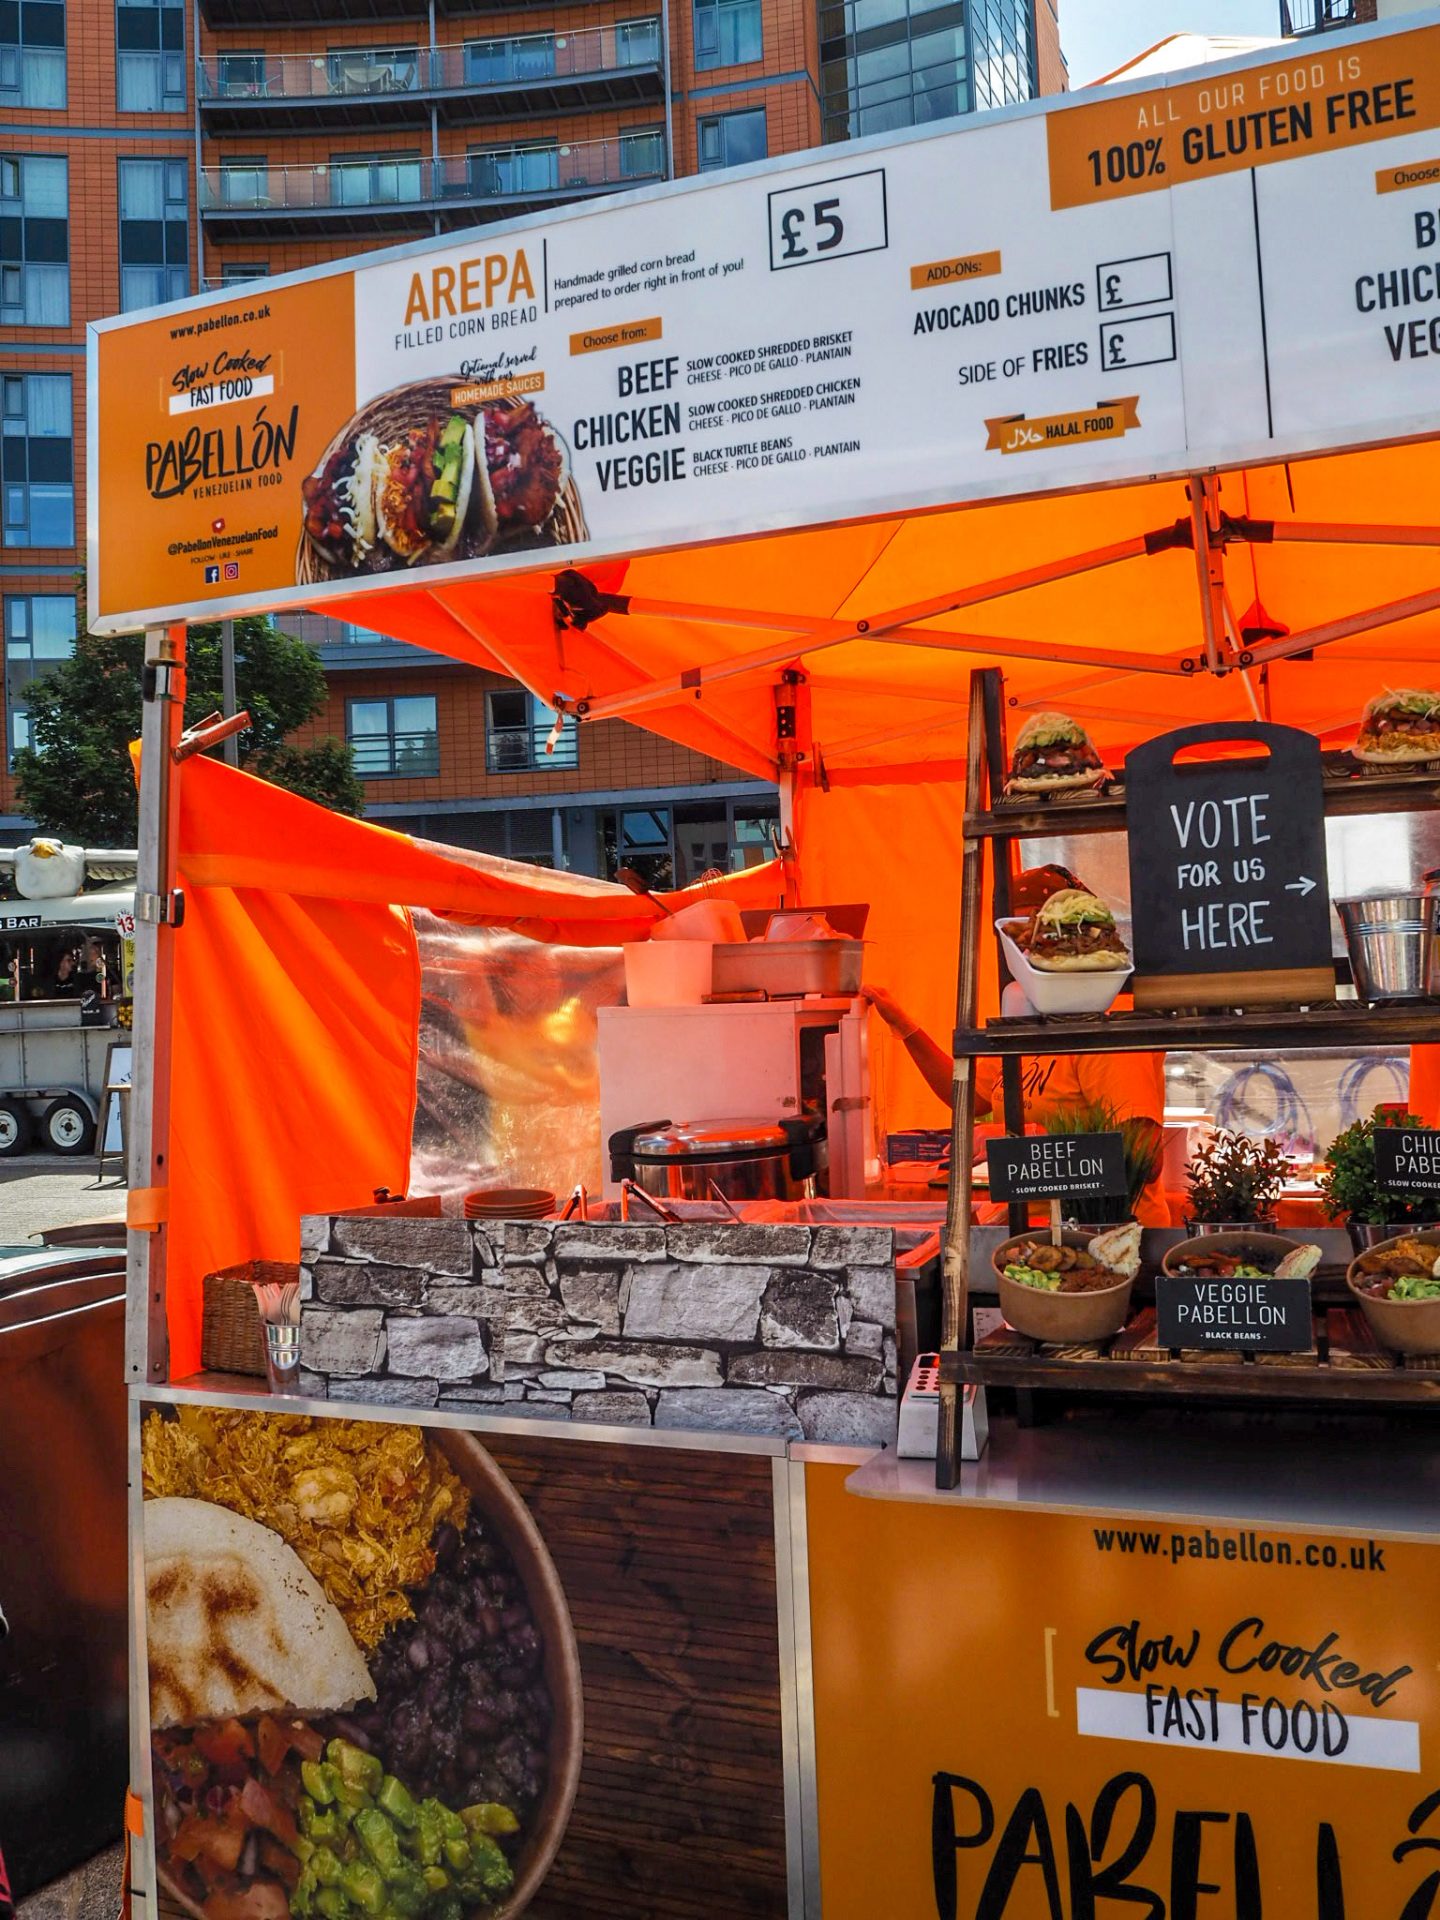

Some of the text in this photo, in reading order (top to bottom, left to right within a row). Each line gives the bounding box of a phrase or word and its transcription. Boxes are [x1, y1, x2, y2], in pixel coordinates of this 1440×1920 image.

[1138, 56, 1362, 130] ALL OUR FOOD IS
[1087, 78, 1416, 187] 100% GLUTEN FREE
[780, 198, 845, 260] £5
[404, 248, 535, 326] AREPA
[554, 249, 696, 291] Handmade grilled corn bread
[554, 258, 745, 311] prepared to order right in front of you!
[170, 305, 271, 340] www.pabellon.co.uk
[395, 305, 538, 351] FILLED CORN BREAD
[913, 282, 1086, 336] AVOCADO CHUNKS
[583, 325, 647, 349] Choose from:
[686, 330, 853, 372] SLOW COOKED SHREDDED BRISKET
[172, 349, 272, 393] Slow Cooked
[617, 355, 680, 398] BEEF
[687, 346, 852, 386] CHEESE PICO DE GALLO PLANTAIN
[958, 341, 1089, 386] SIDE OF FRIES
[190, 376, 253, 408] FAST FOOD
[455, 377, 541, 404] HOMEMADE SAUCES
[688, 377, 861, 417] SLOW COOKED SHREDDED CHICKEN
[573, 401, 681, 451] CHICKEN
[688, 392, 855, 431] CHEESE PICO DE GALLO PLANTAIN
[1045, 415, 1114, 440] HALAL FOOD
[595, 447, 687, 492] VEGGIE
[693, 436, 793, 463] BLACK TURTLE BEANS
[693, 440, 861, 477] CHEESE PICO DE GALLO PLANTAIN
[193, 472, 283, 501] VENEZUELAN FOOD
[168, 525, 278, 556] @PabellonVenezuelanFood
[1169, 792, 1272, 852] VOTE
[1177, 856, 1267, 889] FOR US
[1181, 900, 1274, 950] HERE
[1007, 1158, 1103, 1181] PABELLON
[1030, 1141, 1077, 1161] BEEF
[1016, 1182, 1100, 1194] SLOW COOKED BRISKET
[1388, 1179, 1409, 1187] SLOW
[1194, 1284, 1267, 1304] VEGGIE
[1178, 1305, 1286, 1326] PABELLON
[1205, 1331, 1261, 1340] BLACK BEANS
[1094, 1528, 1387, 1573] www.pabellon.co.uk
[1084, 1616, 1412, 1709] Slow Cooked
[1145, 1684, 1349, 1757] FAST FOOD
